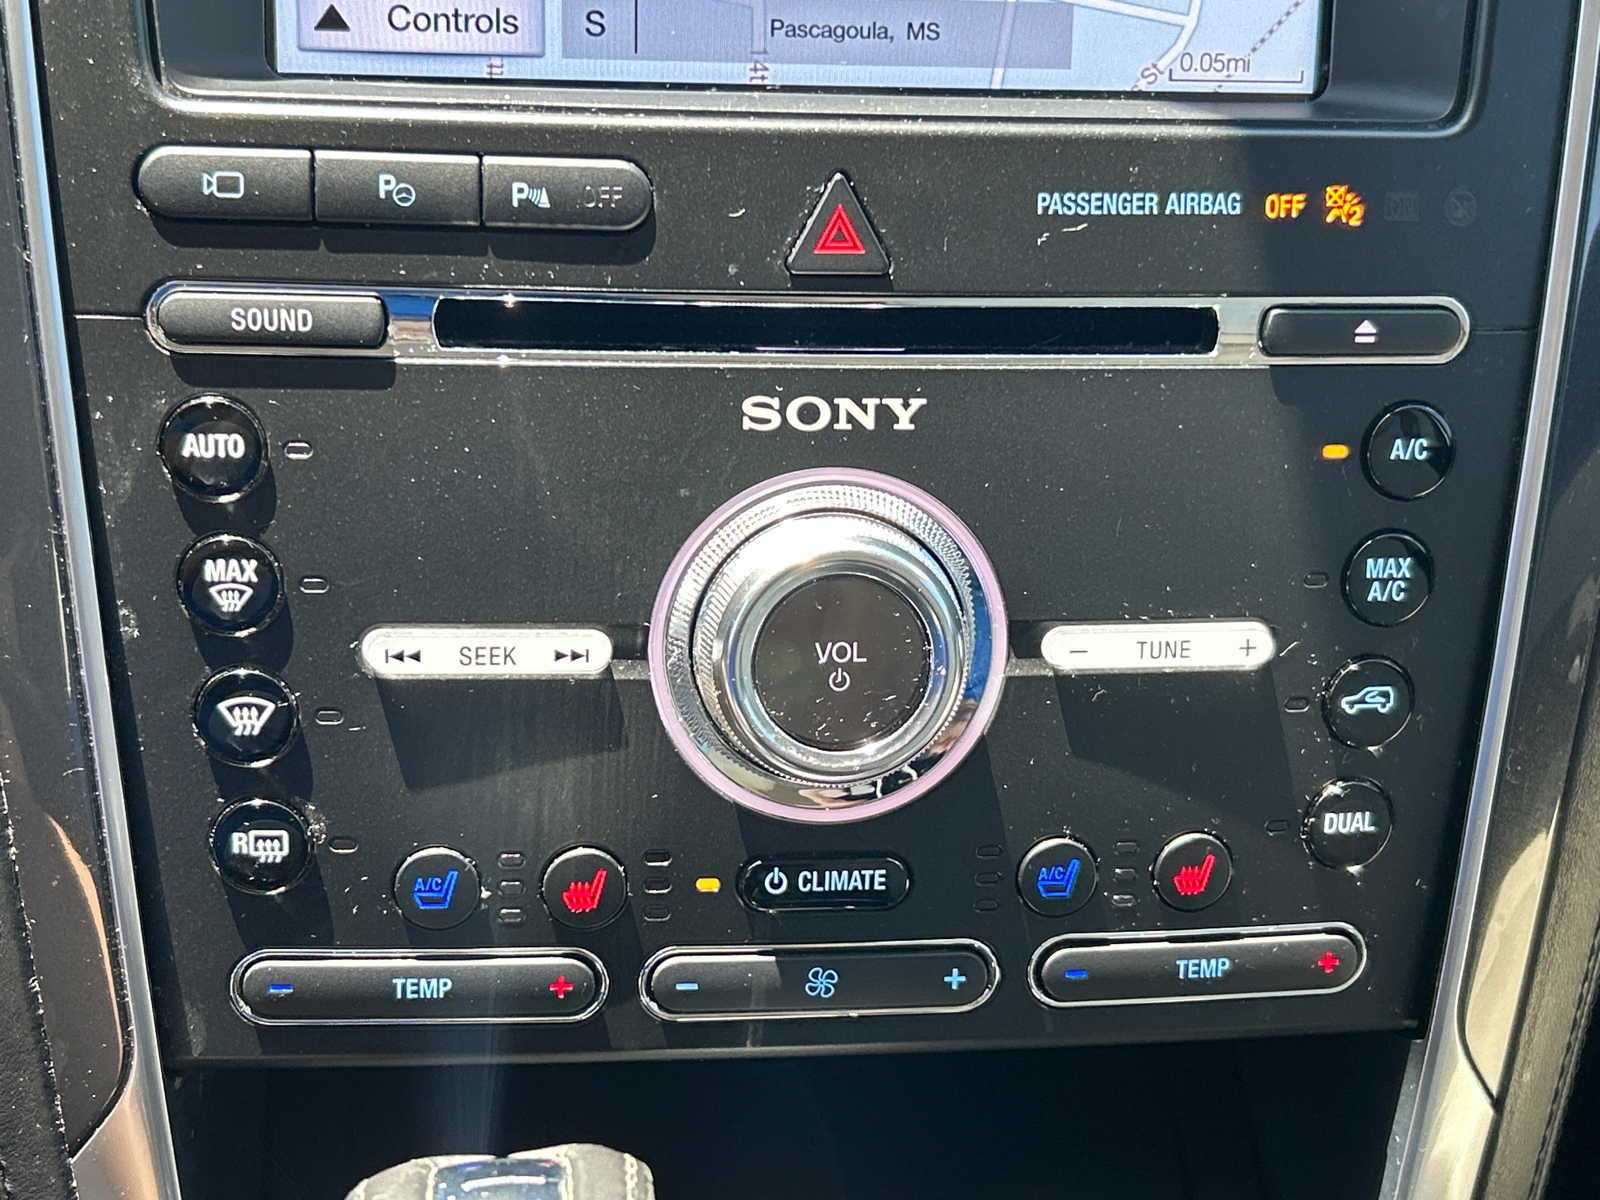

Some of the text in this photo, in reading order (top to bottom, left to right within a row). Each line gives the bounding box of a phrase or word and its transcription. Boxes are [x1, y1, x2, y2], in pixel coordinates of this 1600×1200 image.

[386, 4, 520, 36] Controls
[585, 9, 607, 38] S
[769, 18, 941, 44] Pascagoula, MS
[1140, 62, 1166, 86] St
[1179, 51, 1251, 74] 0.05mi
[1036, 190, 1159, 216] PASSENGER
[1164, 190, 1242, 216] AIRBAG
[1264, 193, 1308, 220] OFF
[230, 307, 314, 333] SOUND
[740, 395, 928, 432] SONY
[181, 432, 247, 460] AUTO
[1389, 438, 1429, 462] A/C
[203, 557, 260, 584] MAX
[1364, 556, 1413, 580] MAX
[1366, 580, 1408, 603] A/C
[458, 645, 518, 667] SEEK
[814, 640, 869, 665] VOL
[1136, 639, 1192, 661] TUNE
[1322, 810, 1377, 836] DUAL
[413, 876, 443, 893] A/C
[797, 868, 888, 893] CLIMATE
[1037, 865, 1066, 882] A/C
[1175, 957, 1231, 980] TEMP
[392, 976, 454, 1000] TEMP
